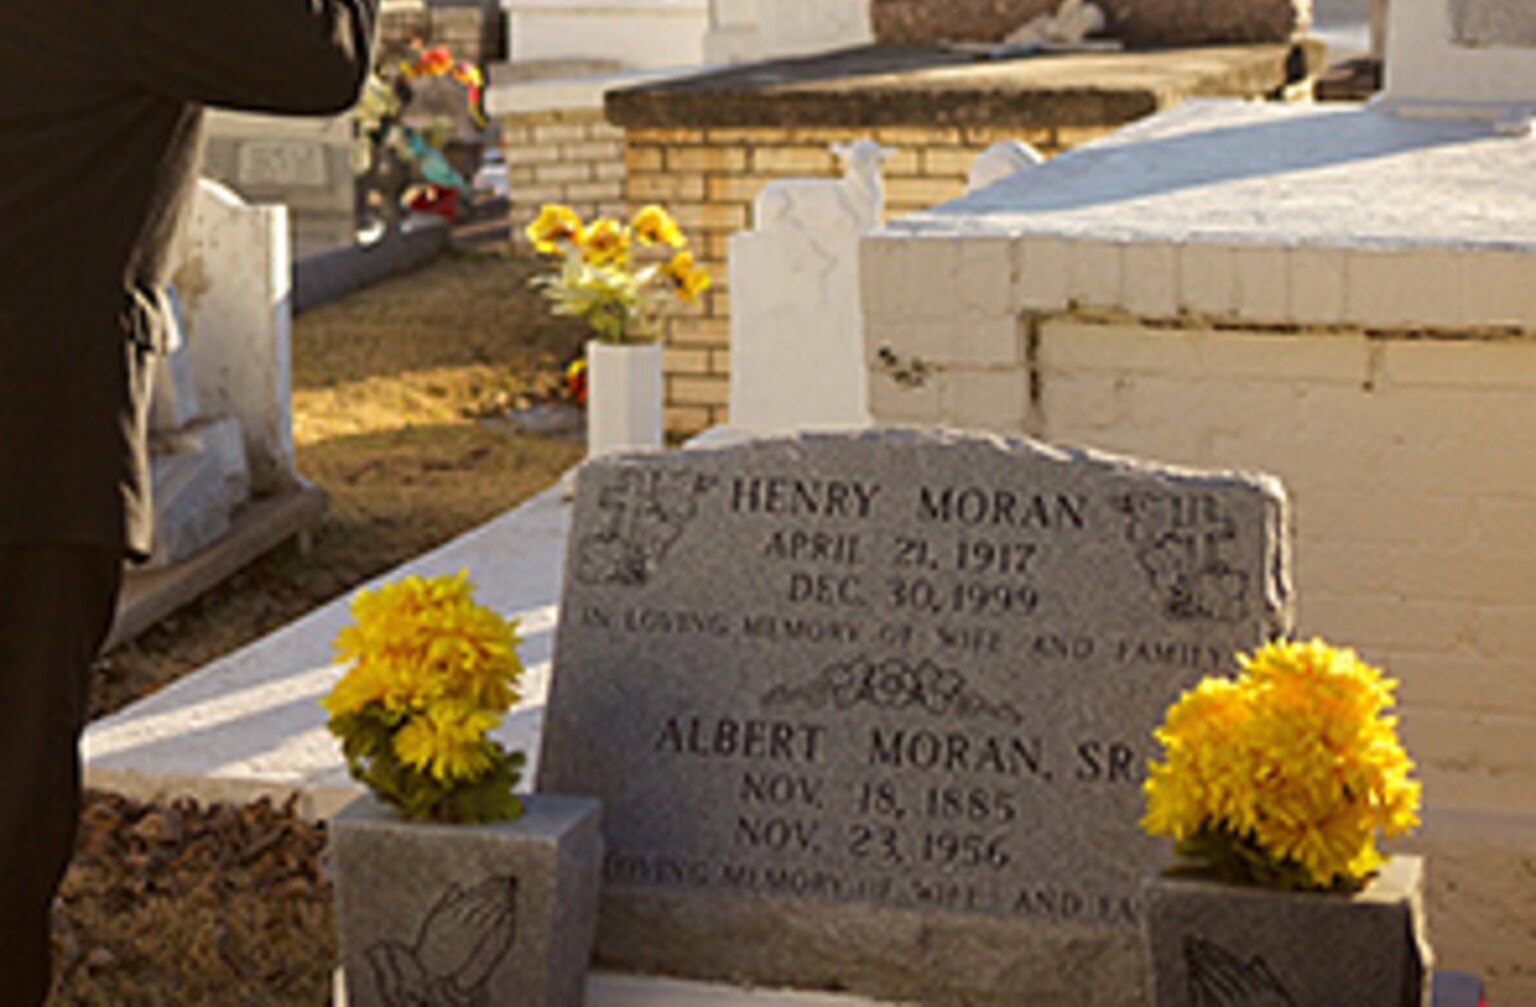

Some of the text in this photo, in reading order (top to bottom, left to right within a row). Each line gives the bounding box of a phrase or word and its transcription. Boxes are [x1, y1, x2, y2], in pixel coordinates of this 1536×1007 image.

[730, 477, 1086, 530] HENRY MORAN
[766, 530, 862, 565] APRIL
[956, 539, 1037, 573] 1917
[952, 581, 1038, 616] 1999
[582, 604, 1226, 676] IN LOVING MEMORY OF WIFE AND FAMILY
[656, 714, 826, 764] ALBERT
[868, 727, 1054, 784] MORAN,
[739, 772, 824, 810] NOV.
[924, 789, 1015, 824] 1885
[732, 815, 822, 853] NOV.
[920, 830, 1011, 870] 1956
[721, 862, 842, 896] MEMORY
[1014, 888, 1082, 922] AND
